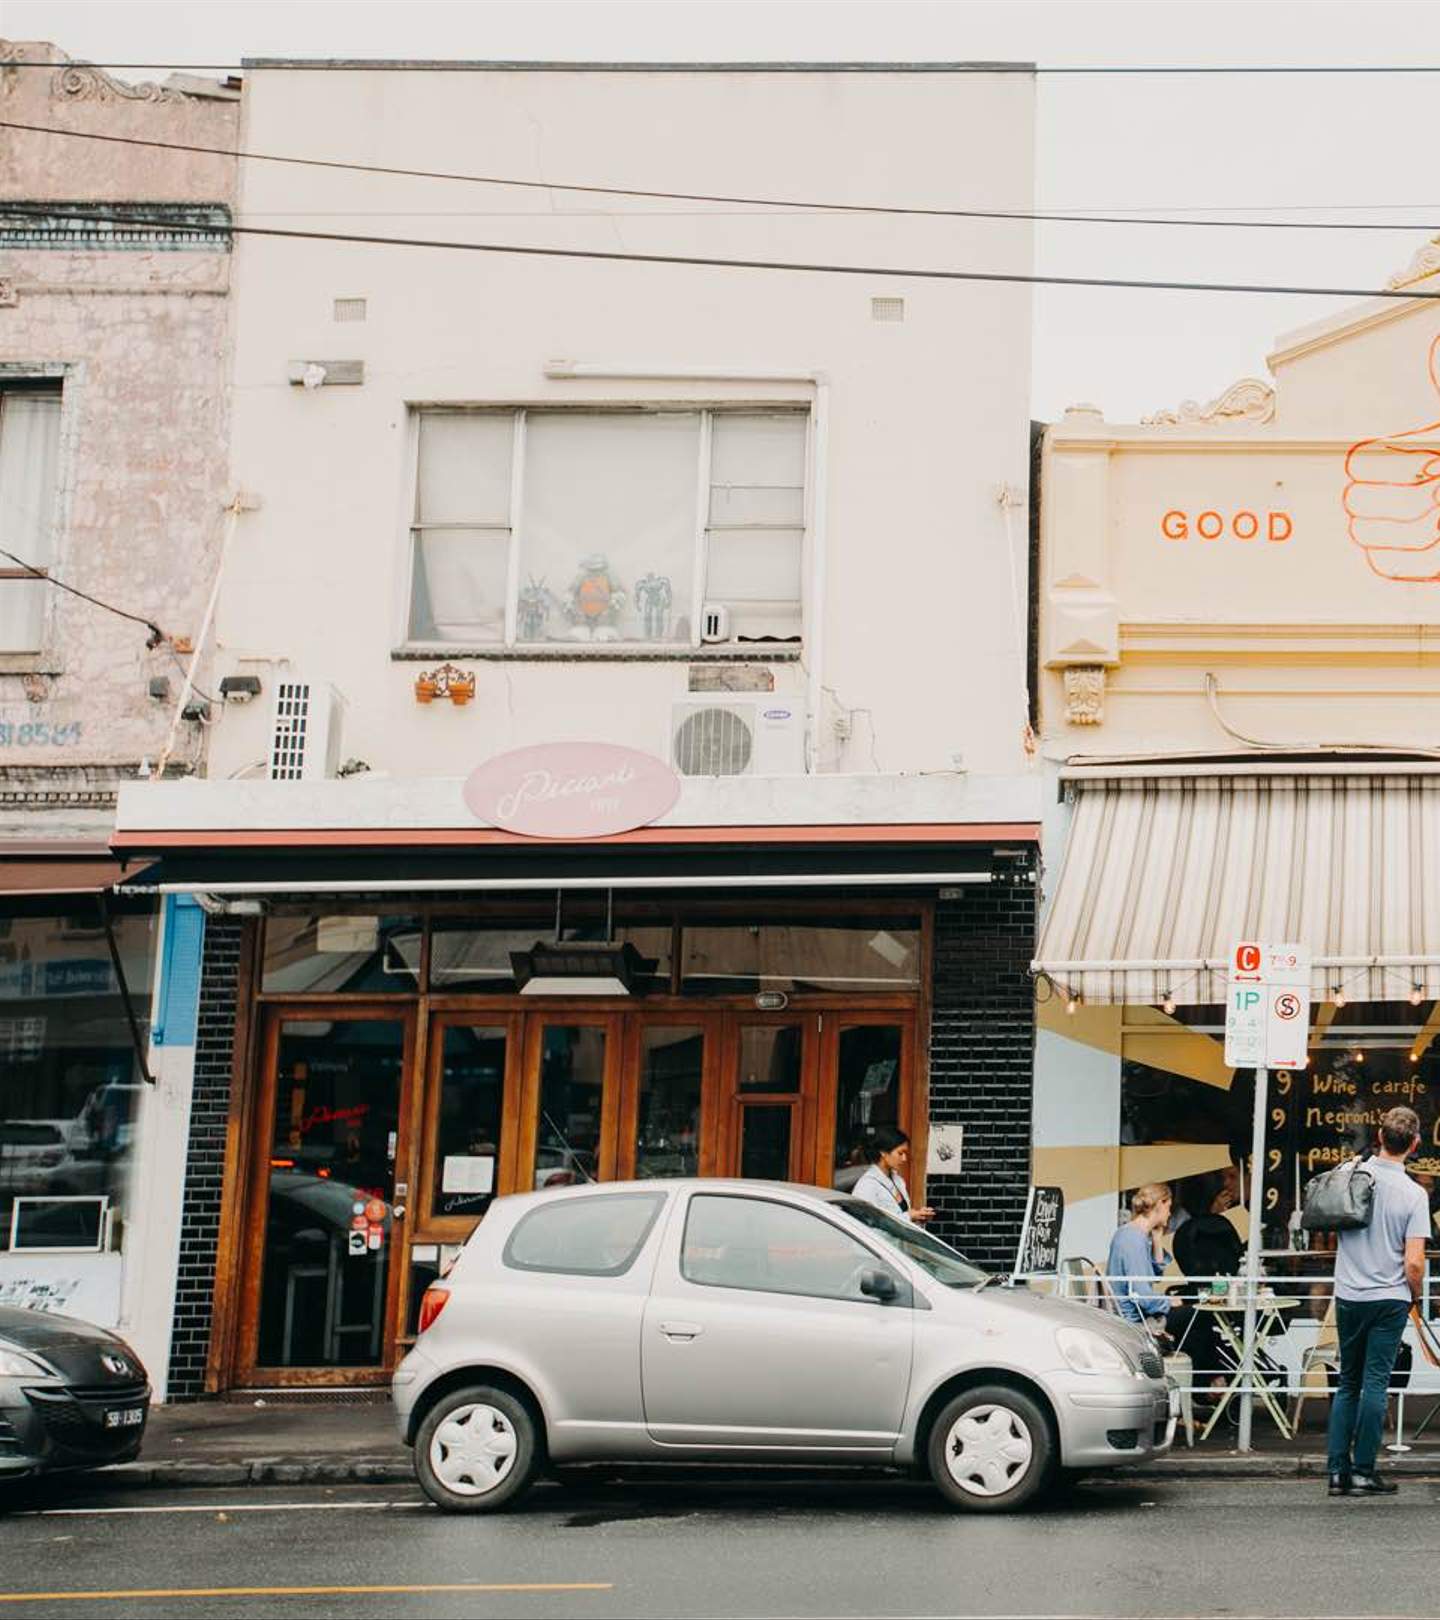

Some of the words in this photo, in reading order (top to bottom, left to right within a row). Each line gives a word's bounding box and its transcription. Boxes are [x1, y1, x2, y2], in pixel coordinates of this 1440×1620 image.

[1161, 510, 1293, 541] GOOD
[1235, 991, 1261, 1011] 1P
[1313, 1074, 1357, 1095] Wine
[1372, 1074, 1427, 1103] carafe
